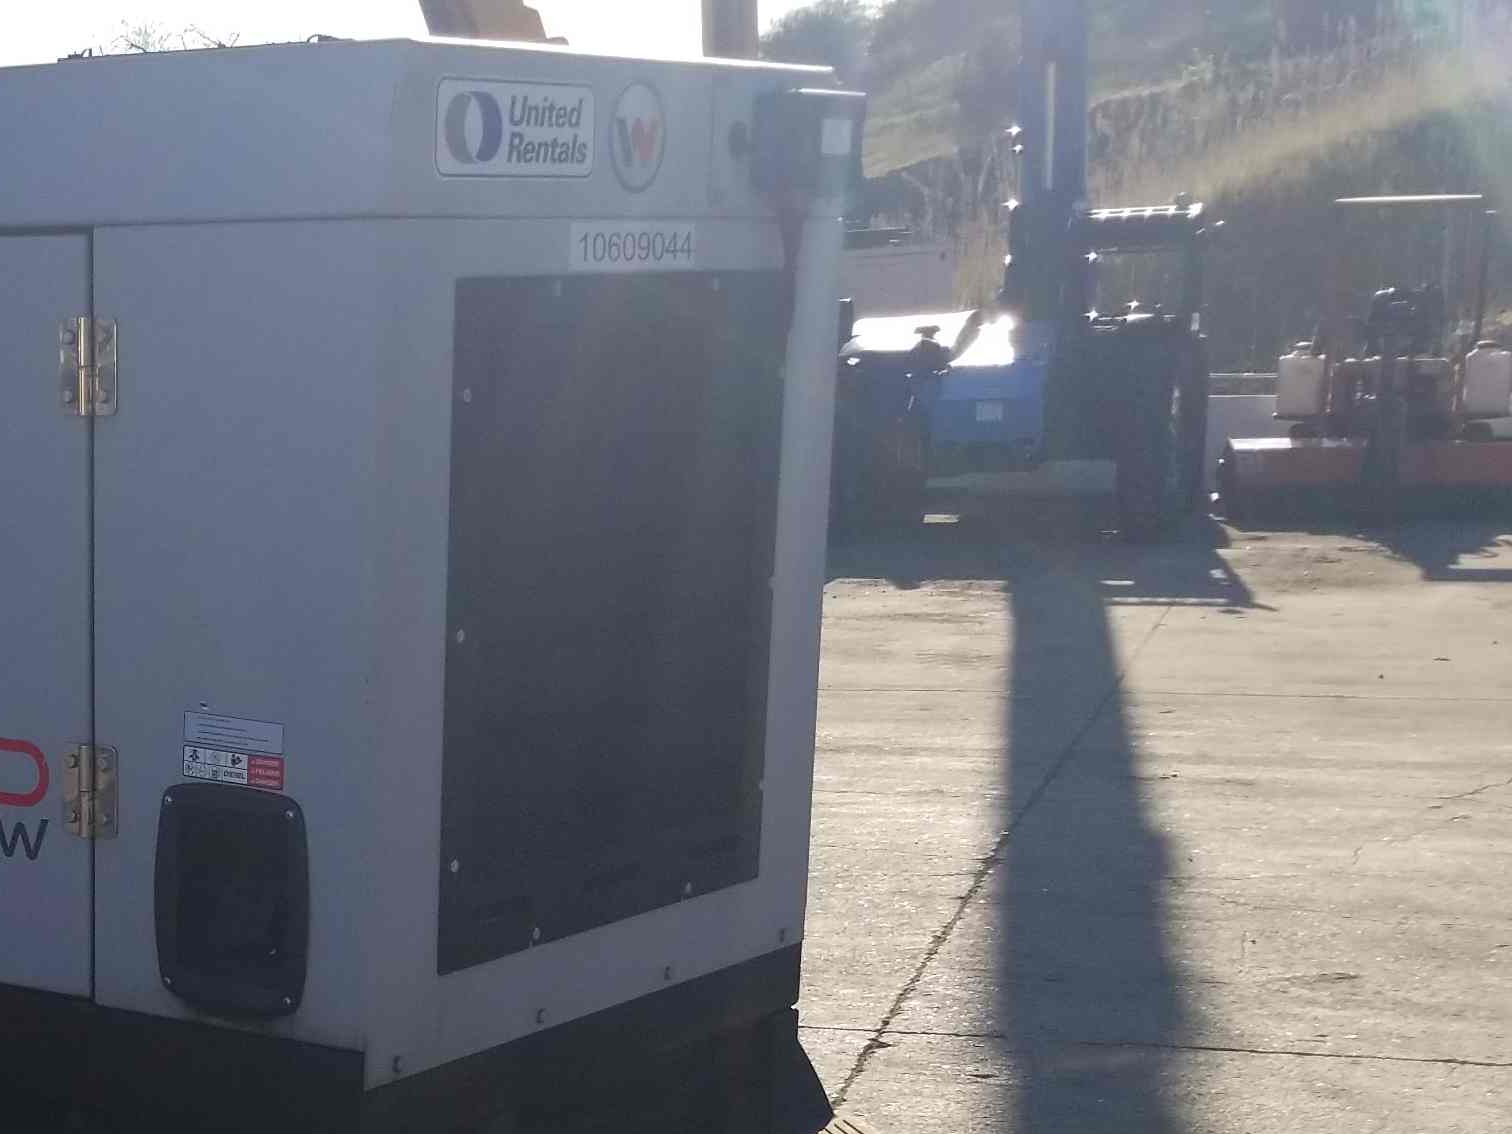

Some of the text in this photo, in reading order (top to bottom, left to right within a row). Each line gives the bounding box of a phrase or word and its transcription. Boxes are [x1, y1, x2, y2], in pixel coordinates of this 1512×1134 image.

[508, 94, 583, 129] United
[506, 131, 587, 165] Rentals
[577, 231, 693, 263] 10609044
